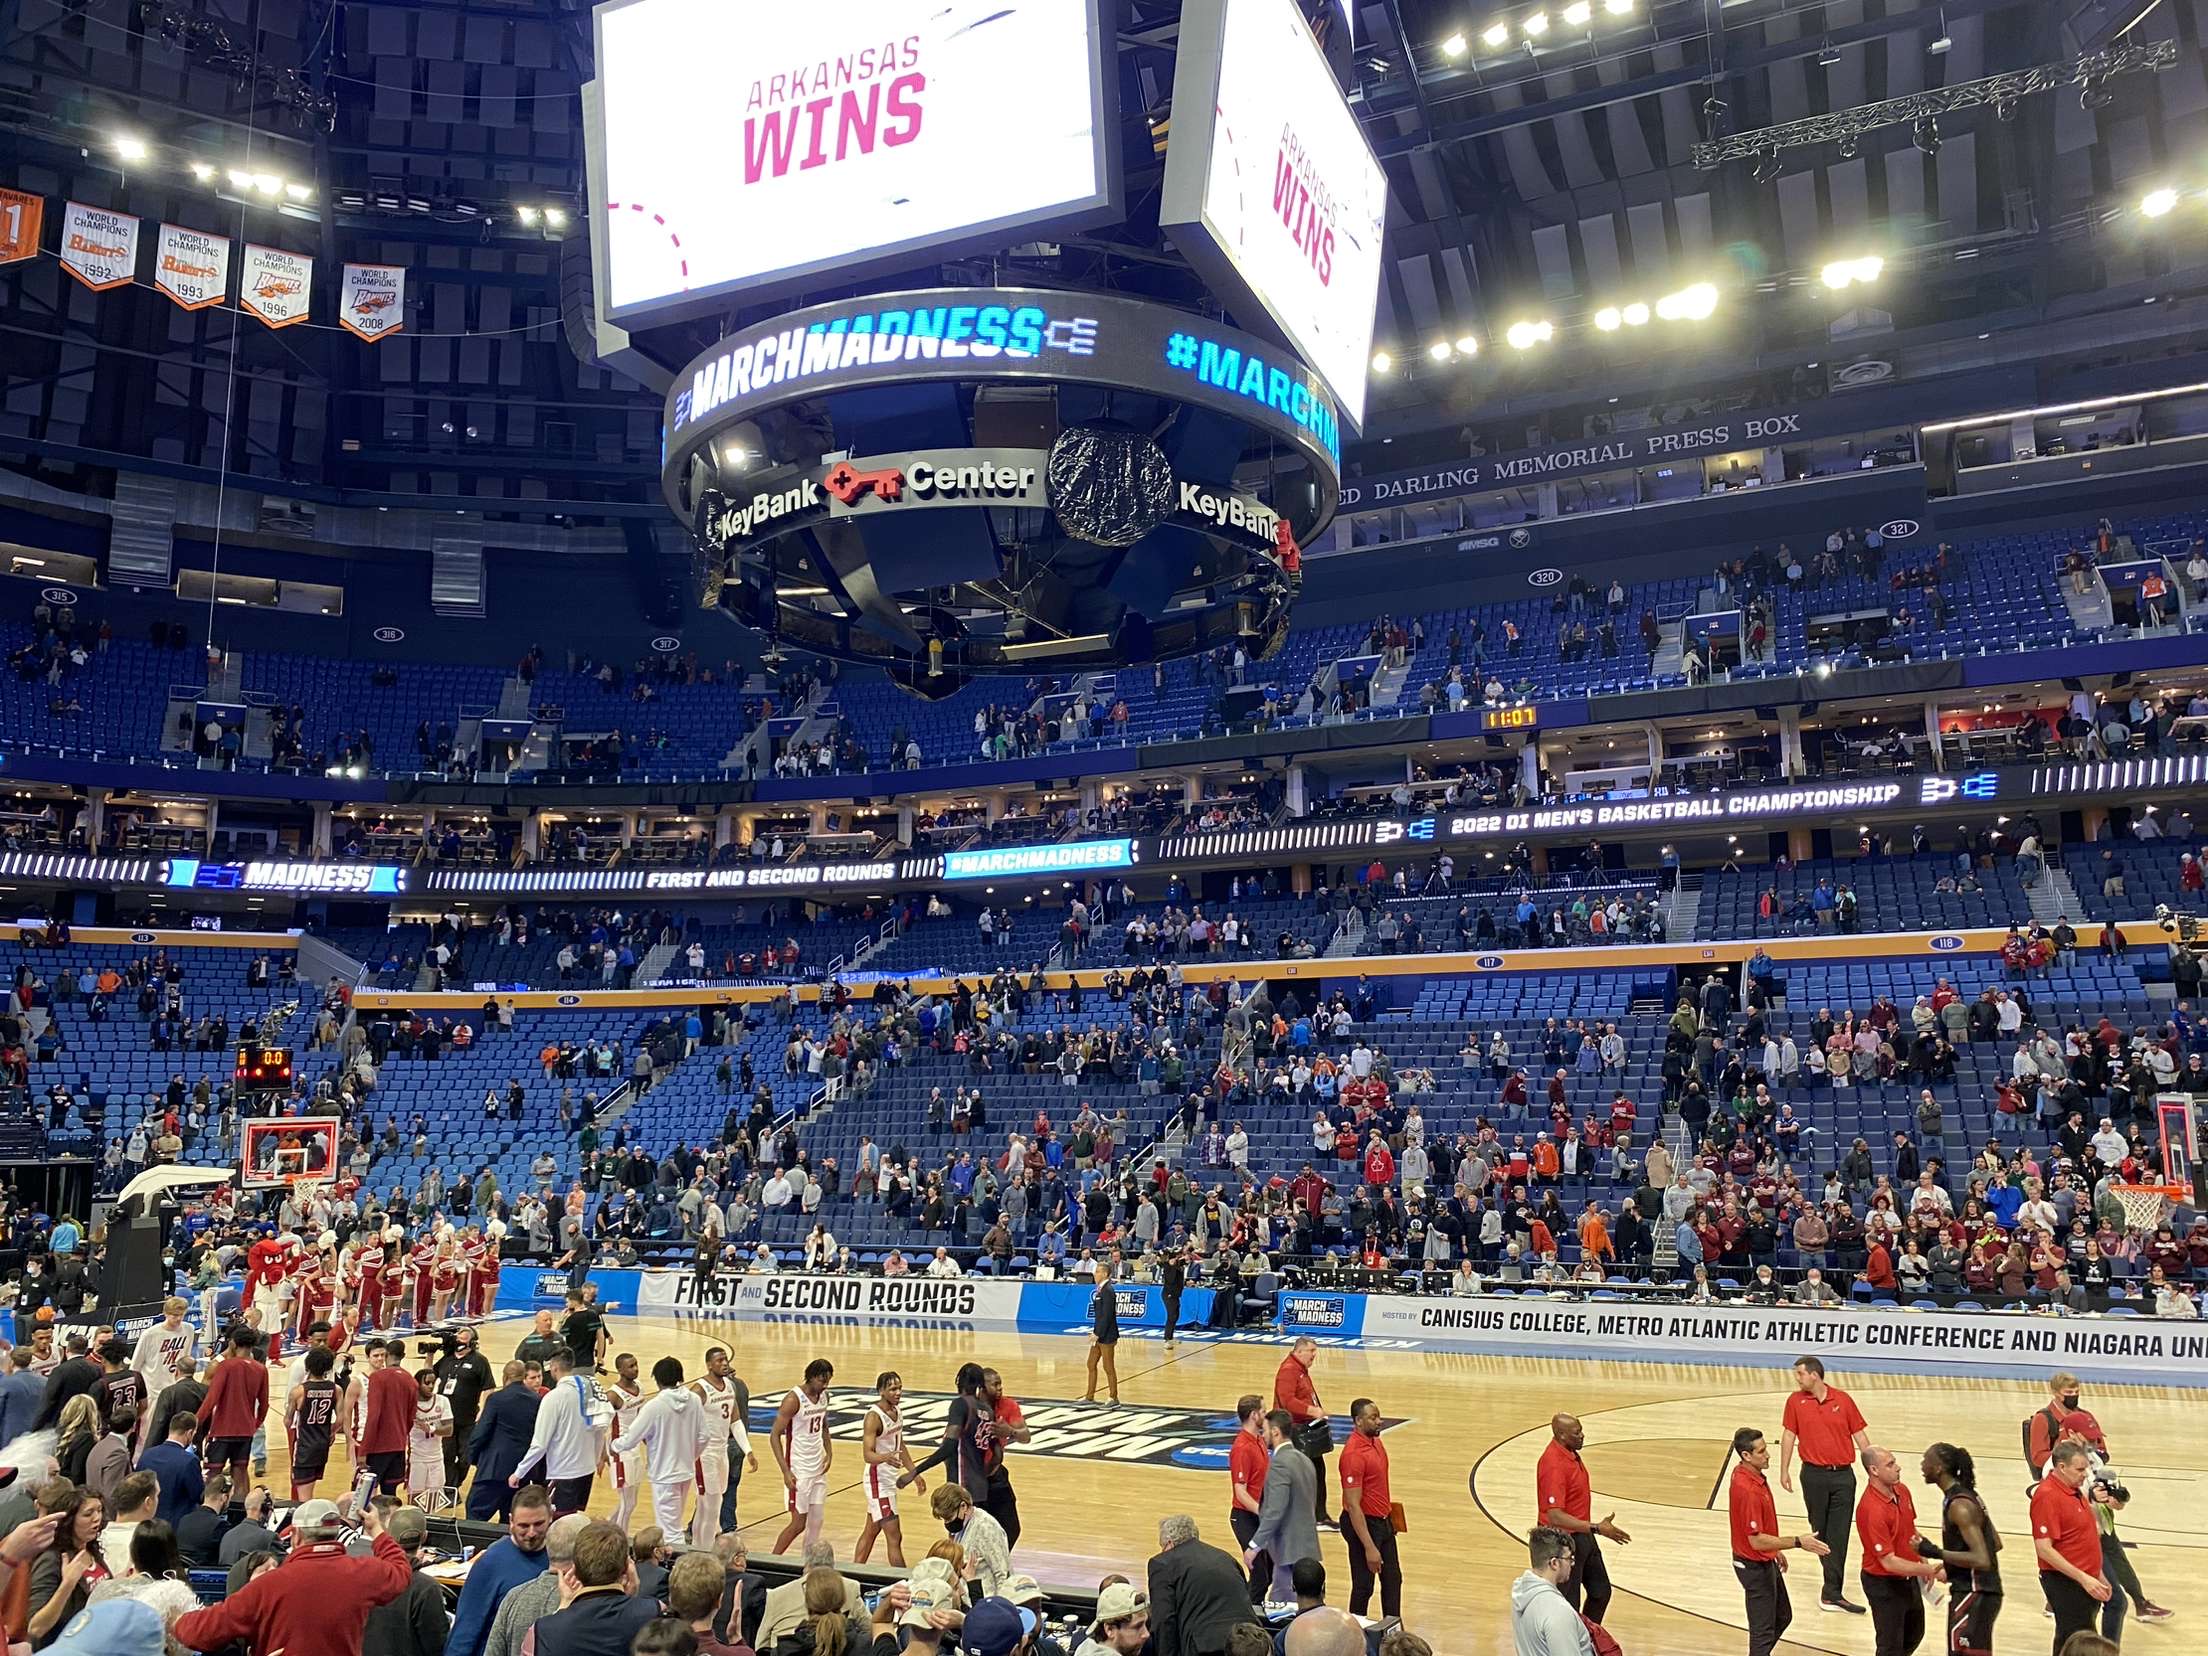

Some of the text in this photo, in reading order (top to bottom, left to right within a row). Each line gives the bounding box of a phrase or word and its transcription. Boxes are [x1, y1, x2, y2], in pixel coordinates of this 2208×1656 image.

[745, 35, 920, 112] ARKANSAS
[744, 72, 926, 184] WINS
[1280, 122, 1338, 228] ARKANSAS
[86, 210, 118, 226] WORLD
[1273, 148, 1335, 287] WINS
[74, 217, 128, 237] CHAMPIONS
[167, 238, 219, 257] CHAMPIONS
[178, 232, 210, 246] WORLD
[253, 257, 303, 276] CHAMPIONS
[264, 251, 294, 265] WORLD
[84, 263, 112, 279] 1992
[361, 269, 389, 279] WORLD
[351, 276, 397, 287] CHAMPIONS
[177, 283, 203, 299] 1993
[262, 301, 288, 317] 1996
[358, 317, 383, 329] 2008
[1374, 467, 1479, 500] DARLING
[1494, 443, 1634, 480] MEMORIAL
[1646, 425, 1730, 455] PRESS
[1745, 414, 1800, 439] BOX
[720, 461, 1035, 541] KeyBank Center
[1180, 481, 1280, 545] KeyBank
[1890, 523, 1908, 535] 321
[1536, 572, 1555, 583] 320
[51, 591, 68, 601] 315
[1489, 708, 1534, 727] 11:07
[1451, 816, 1501, 835] 2022
[1507, 814, 1530, 832] DI
[1534, 808, 1594, 830] MEN'S
[1597, 799, 1723, 826] BASKETBALL
[1728, 784, 1900, 816] CHAMPIONSHIP
[951, 845, 1123, 873] #MARCHMADNESS
[247, 863, 372, 888] MADNESS
[647, 863, 895, 888] FIRST AND SECOND ROUNDS
[137, 934, 149, 942] 113
[1938, 937, 1953, 948] 118
[1483, 958, 1496, 967] 117
[563, 996, 575, 1004] 114
[546, 1284, 569, 1294] MADNE
[741, 1286, 762, 1299] AND
[764, 1278, 862, 1311] SECOND
[868, 1281, 976, 1315] ROUNDS
[1294, 1299, 1328, 1312] MARCH
[124, 1318, 154, 1331] MARCH
[1298, 1310, 1343, 1324] MADNESS
[1382, 1312, 1405, 1320] HOSTED
[1407, 1312, 1417, 1320] BY
[1421, 1308, 1504, 1330] CANISIUS
[1509, 1312, 1592, 1336] COLLEGE,
[1597, 1315, 1663, 1337] METRO
[1668, 1317, 1760, 1340] ATLANTIC
[1765, 1320, 1859, 1344] ATHLETIC
[1865, 1323, 2004, 1350] CONFERENCE
[2011, 1329, 2057, 1352] AND
[2064, 1331, 2163, 1357] NIAGARA
[160, 1335, 188, 1353] BALL
[113, 1385, 137, 1409] 23
[307, 1399, 332, 1425] 12
[721, 1403, 729, 1419] 3
[809, 1415, 821, 1433] 13
